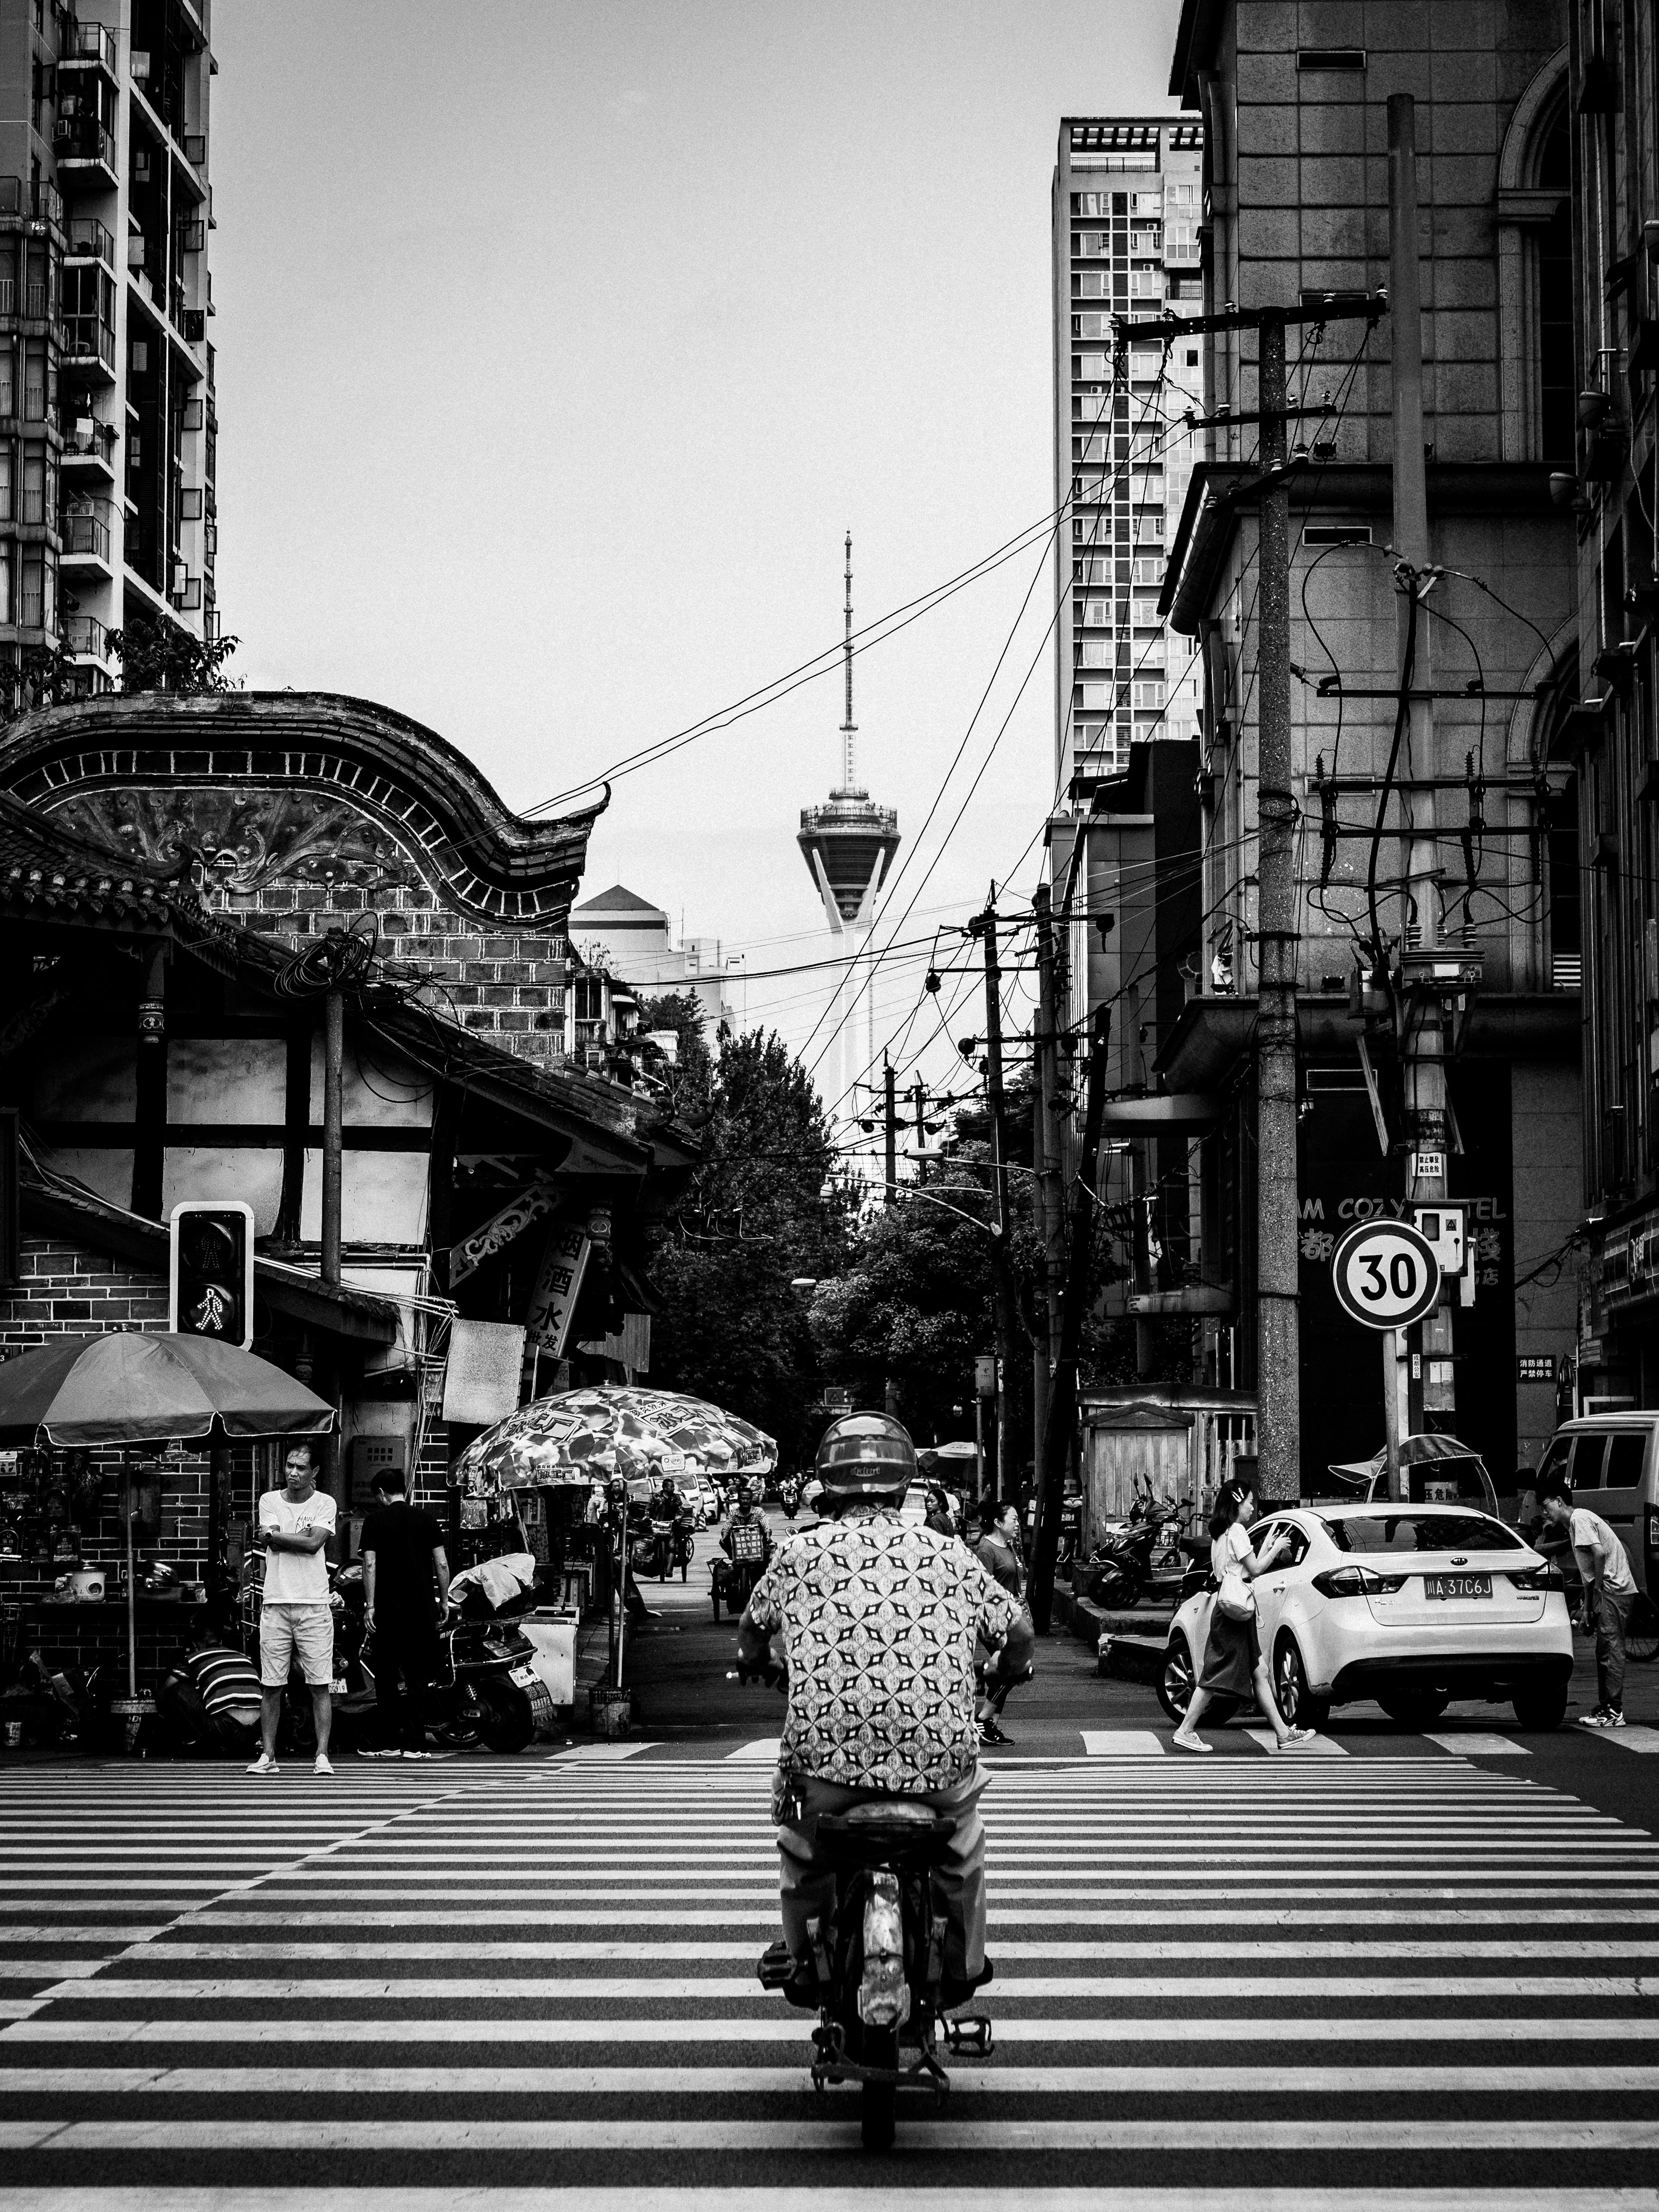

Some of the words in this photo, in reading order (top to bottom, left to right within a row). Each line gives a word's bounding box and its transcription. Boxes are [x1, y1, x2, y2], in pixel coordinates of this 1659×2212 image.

[1419, 1165, 1440, 1174] 高压危险
[532, 1230, 585, 1331] 烟酒水
[1359, 1253, 1416, 1301] 30
[1519, 1359, 1552, 1367] 消防通道
[1519, 1369, 1553, 1377] 严禁停车
